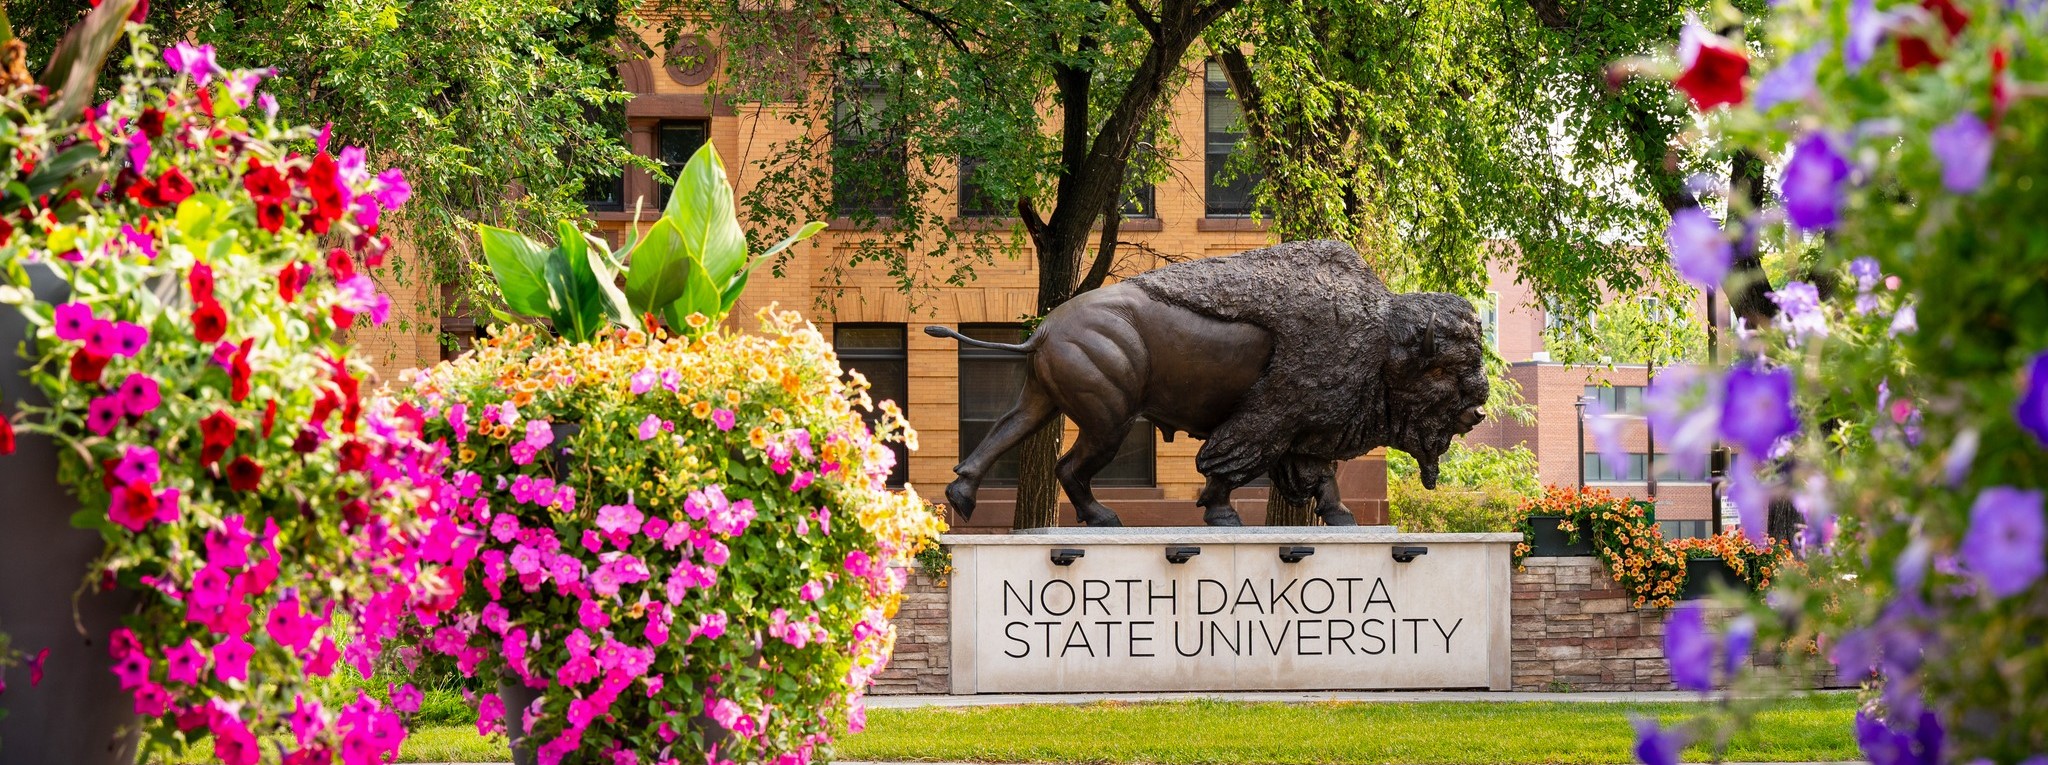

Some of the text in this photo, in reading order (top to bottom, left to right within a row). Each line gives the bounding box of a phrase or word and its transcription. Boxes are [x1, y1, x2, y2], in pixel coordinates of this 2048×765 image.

[1003, 577, 1396, 617] NORTH DAKOTA
[1004, 617, 1463, 659] STATE UNIVERSITY
